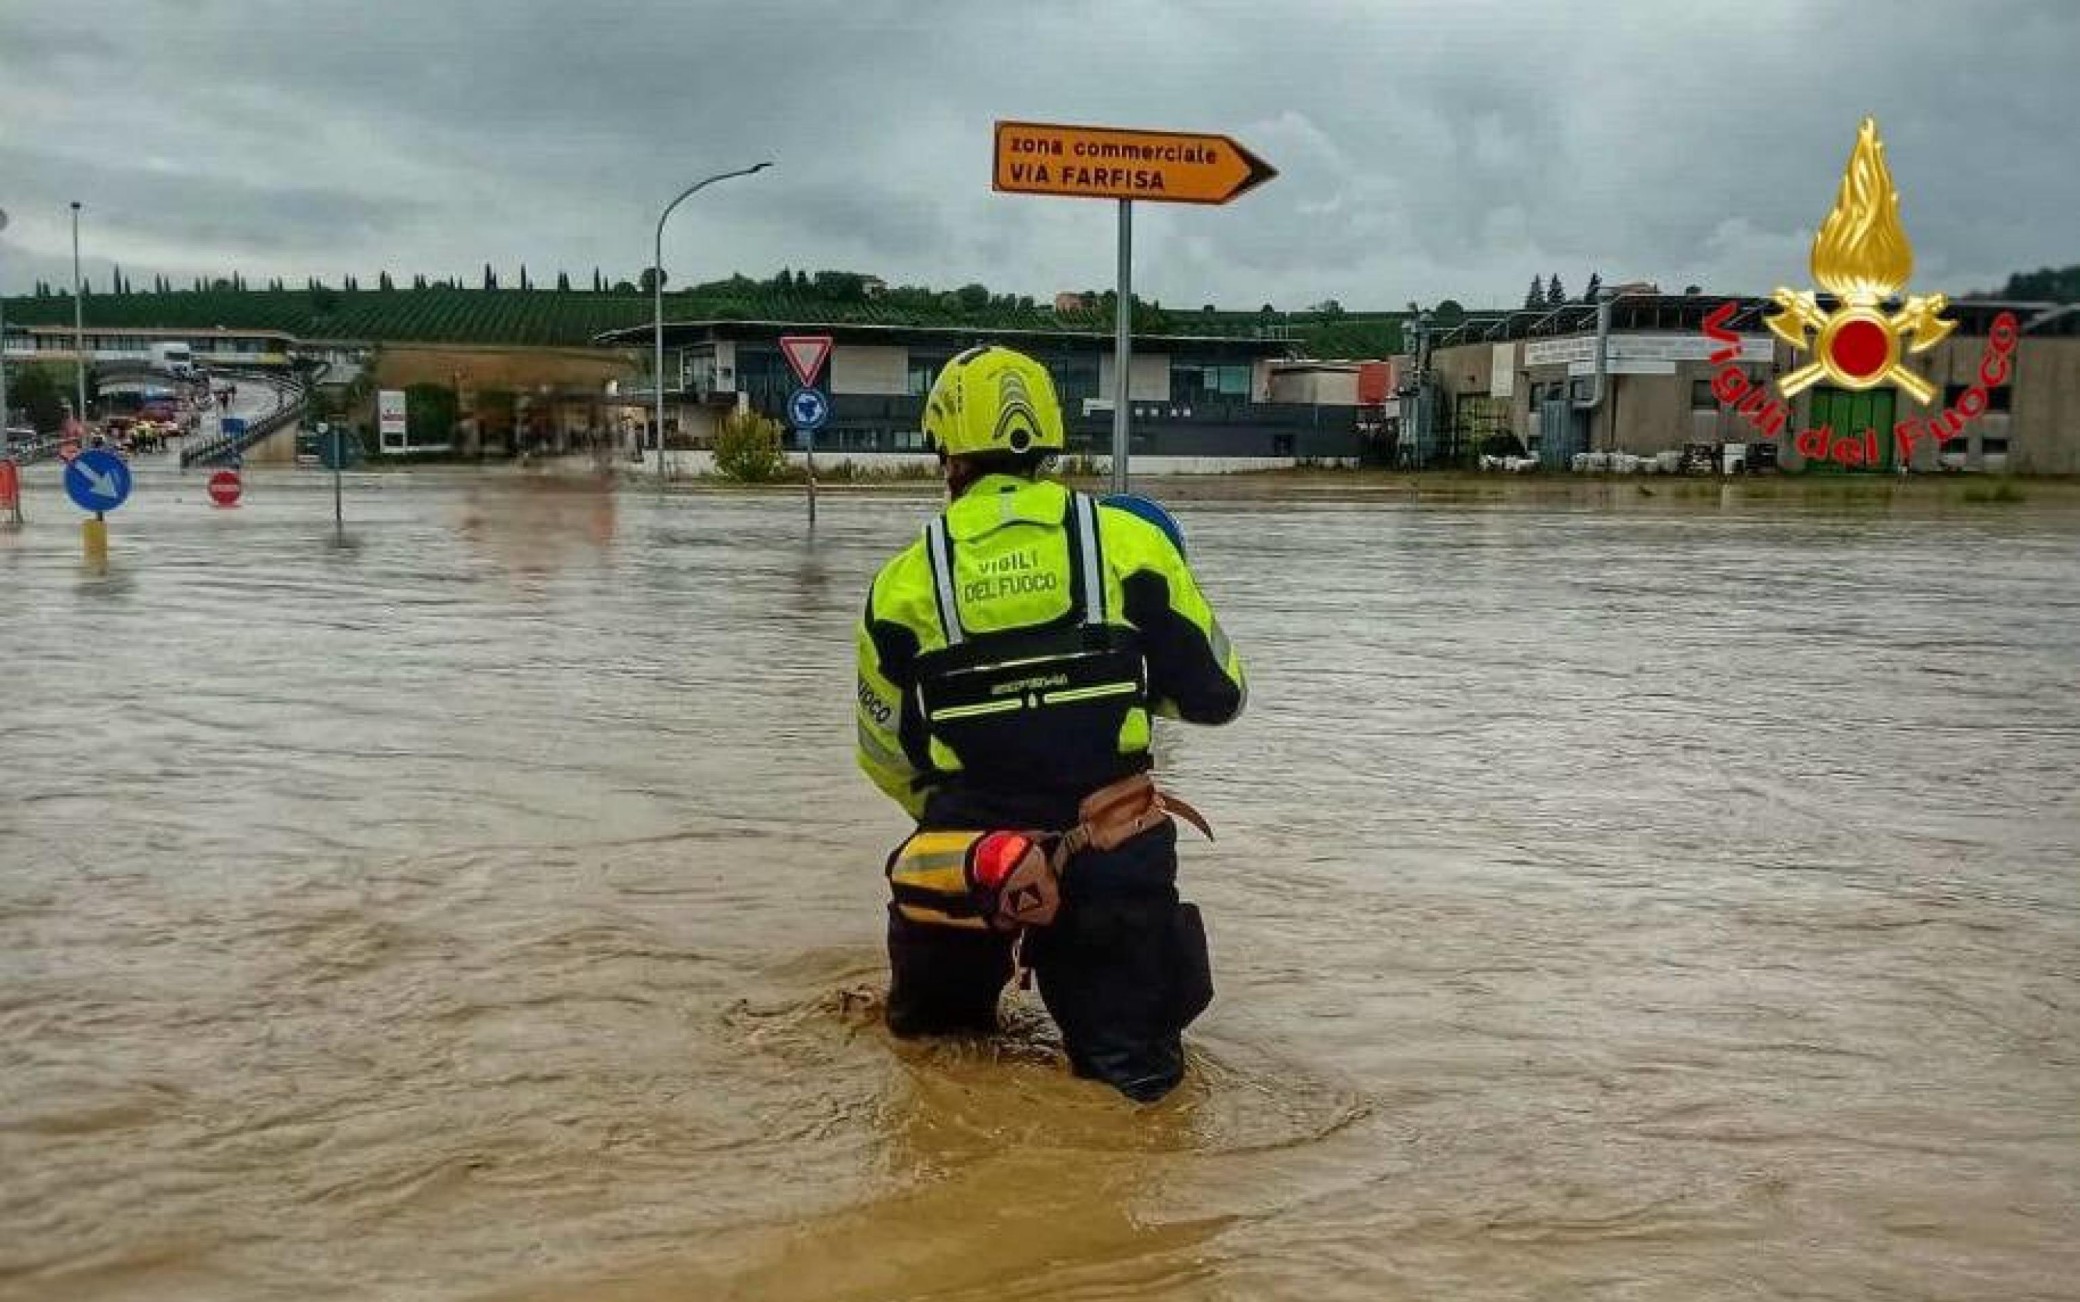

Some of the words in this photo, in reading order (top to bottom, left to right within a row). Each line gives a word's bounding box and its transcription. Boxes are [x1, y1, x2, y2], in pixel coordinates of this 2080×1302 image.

[1011, 137, 1064, 156] zona
[1073, 141, 1216, 165] commerciale
[1010, 163, 1049, 183] VIA
[1062, 165, 1165, 190] FARFISA
[979, 551, 1038, 574] VIGILI
[964, 580, 998, 603] DEL
[999, 572, 1057, 598] FUOCO
